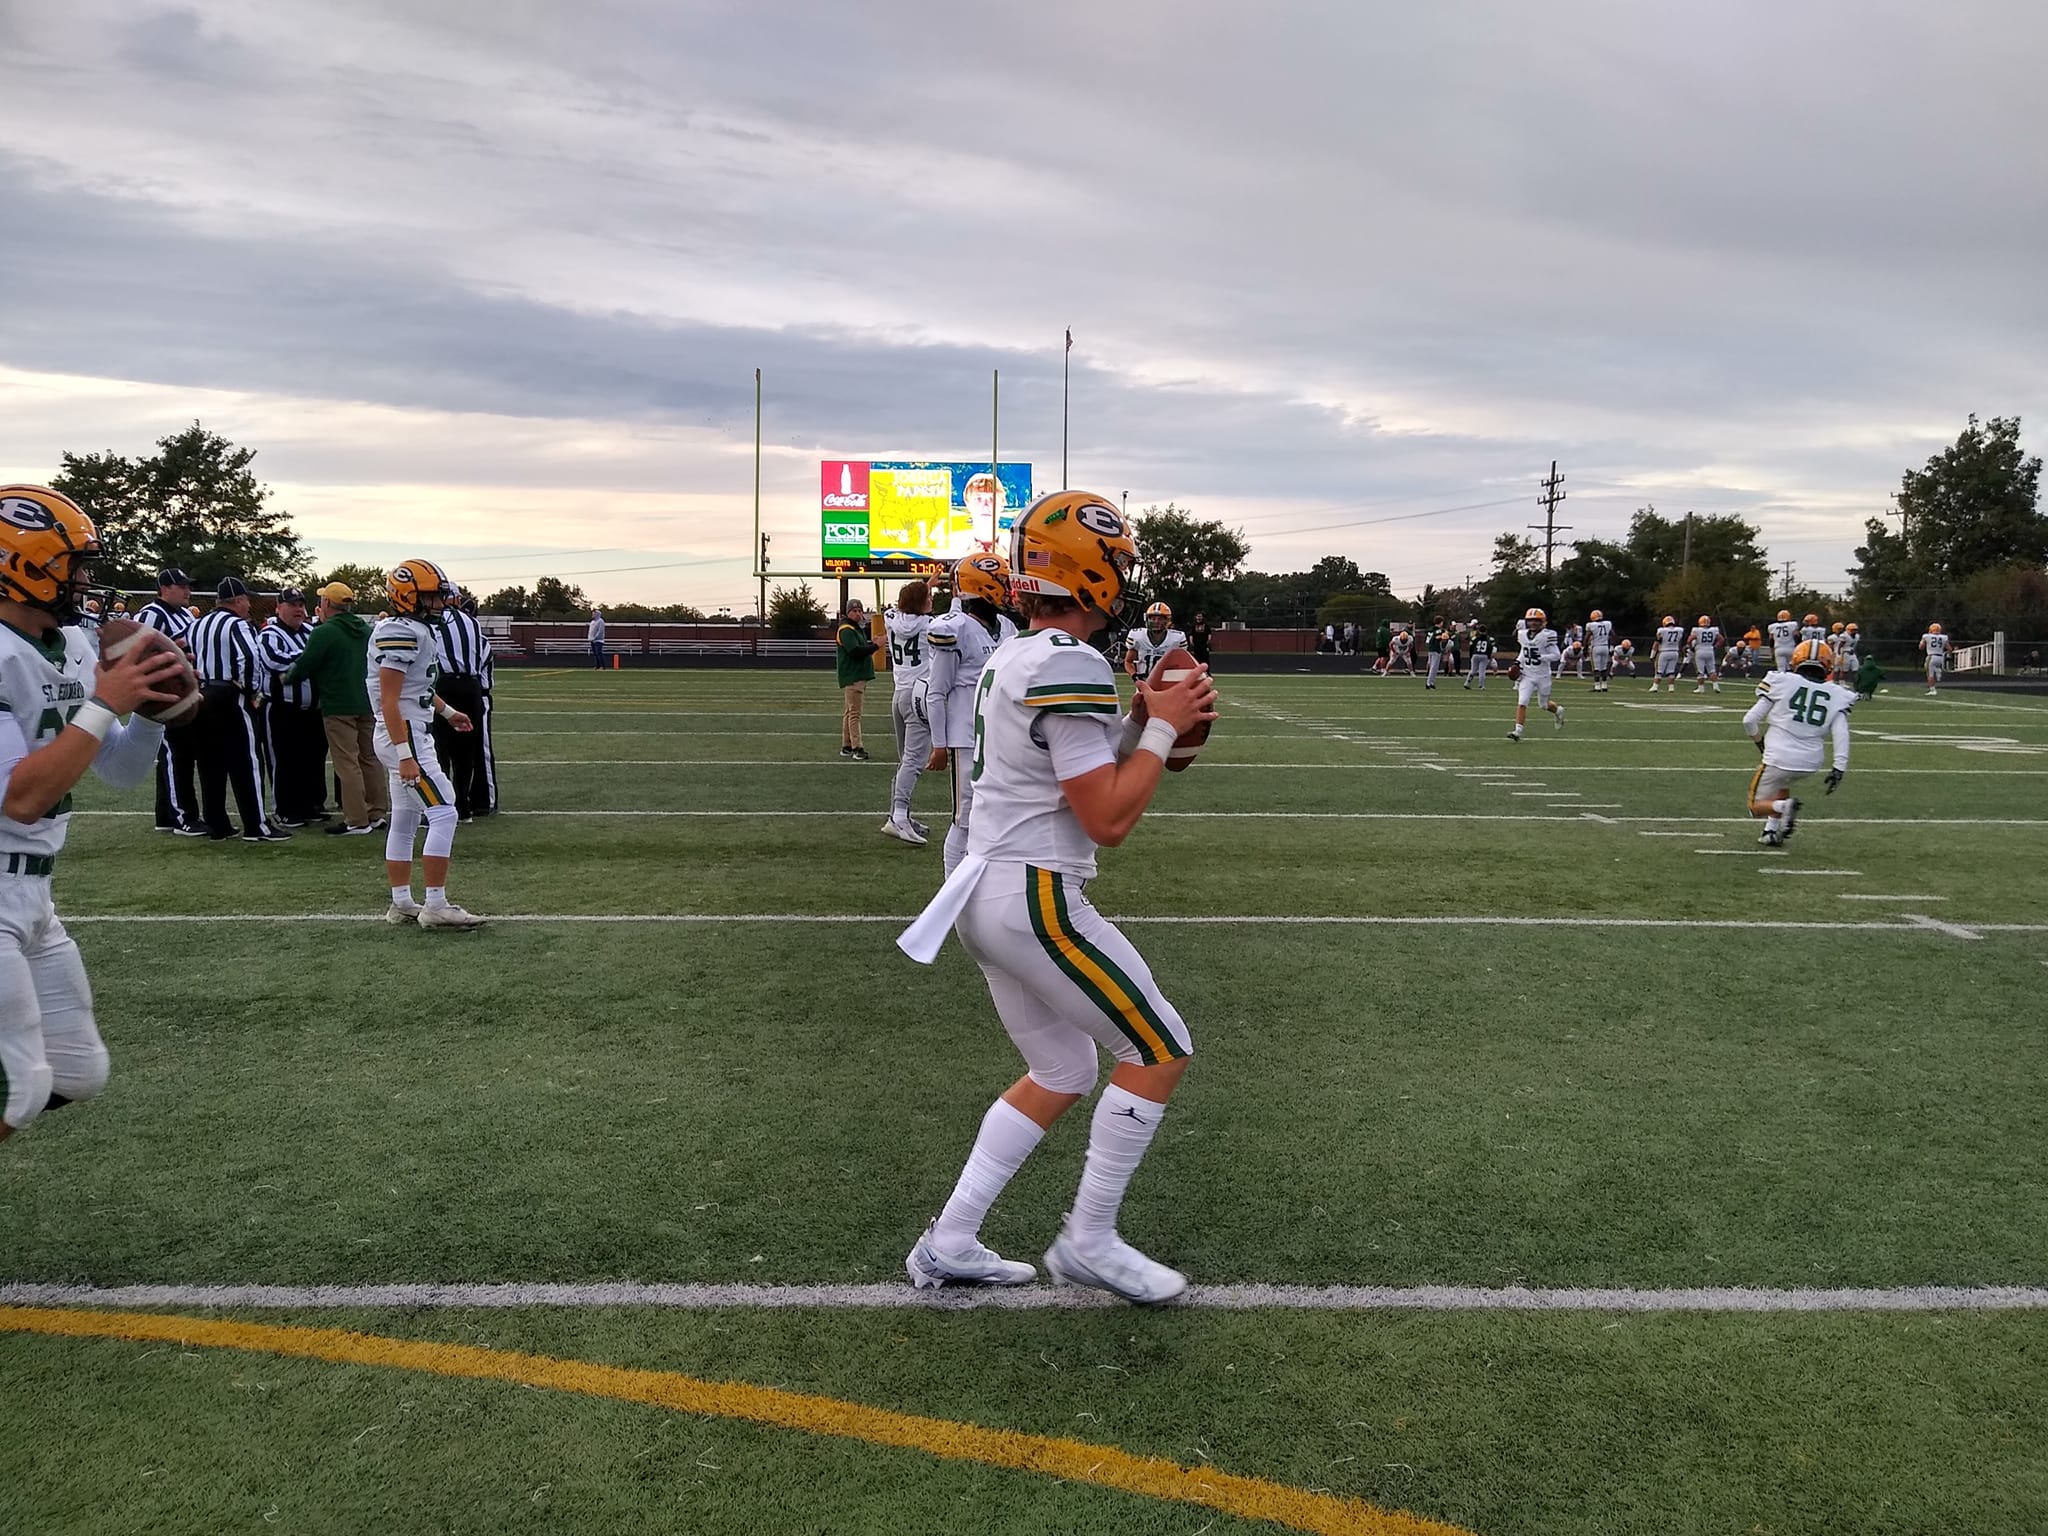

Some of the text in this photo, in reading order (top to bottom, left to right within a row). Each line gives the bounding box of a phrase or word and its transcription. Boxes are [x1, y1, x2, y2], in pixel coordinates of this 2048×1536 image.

[1083, 506, 1120, 535] E
[825, 523, 869, 537] PCSD
[917, 519, 947, 547] 14
[1667, 631, 1679, 642] 77
[1776, 626, 1789, 638] 76
[1476, 640, 1488, 653] 49
[1789, 686, 1830, 727] 46
